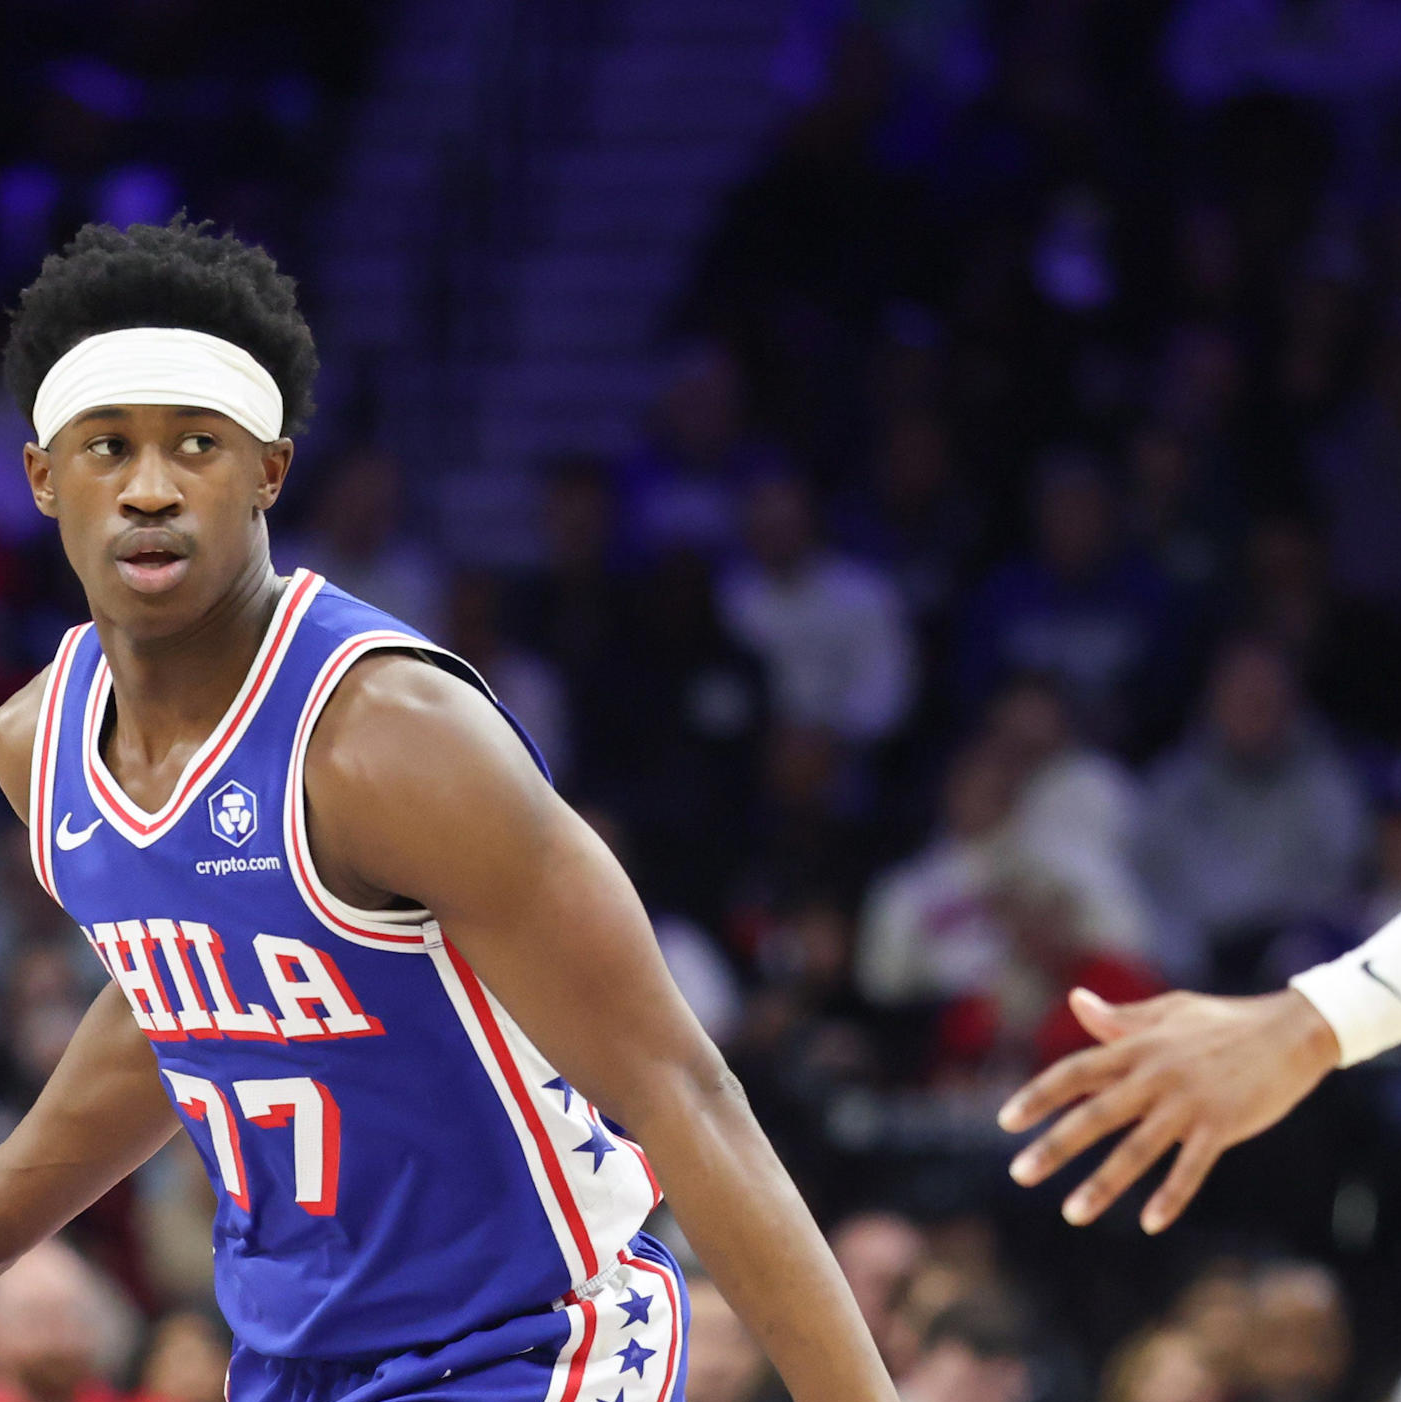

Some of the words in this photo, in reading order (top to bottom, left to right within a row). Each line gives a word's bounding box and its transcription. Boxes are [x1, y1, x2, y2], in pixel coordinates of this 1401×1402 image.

[195, 856, 281, 876] crypto.com
[79, 918, 386, 1045] HILA
[160, 1068, 342, 1217] 77
